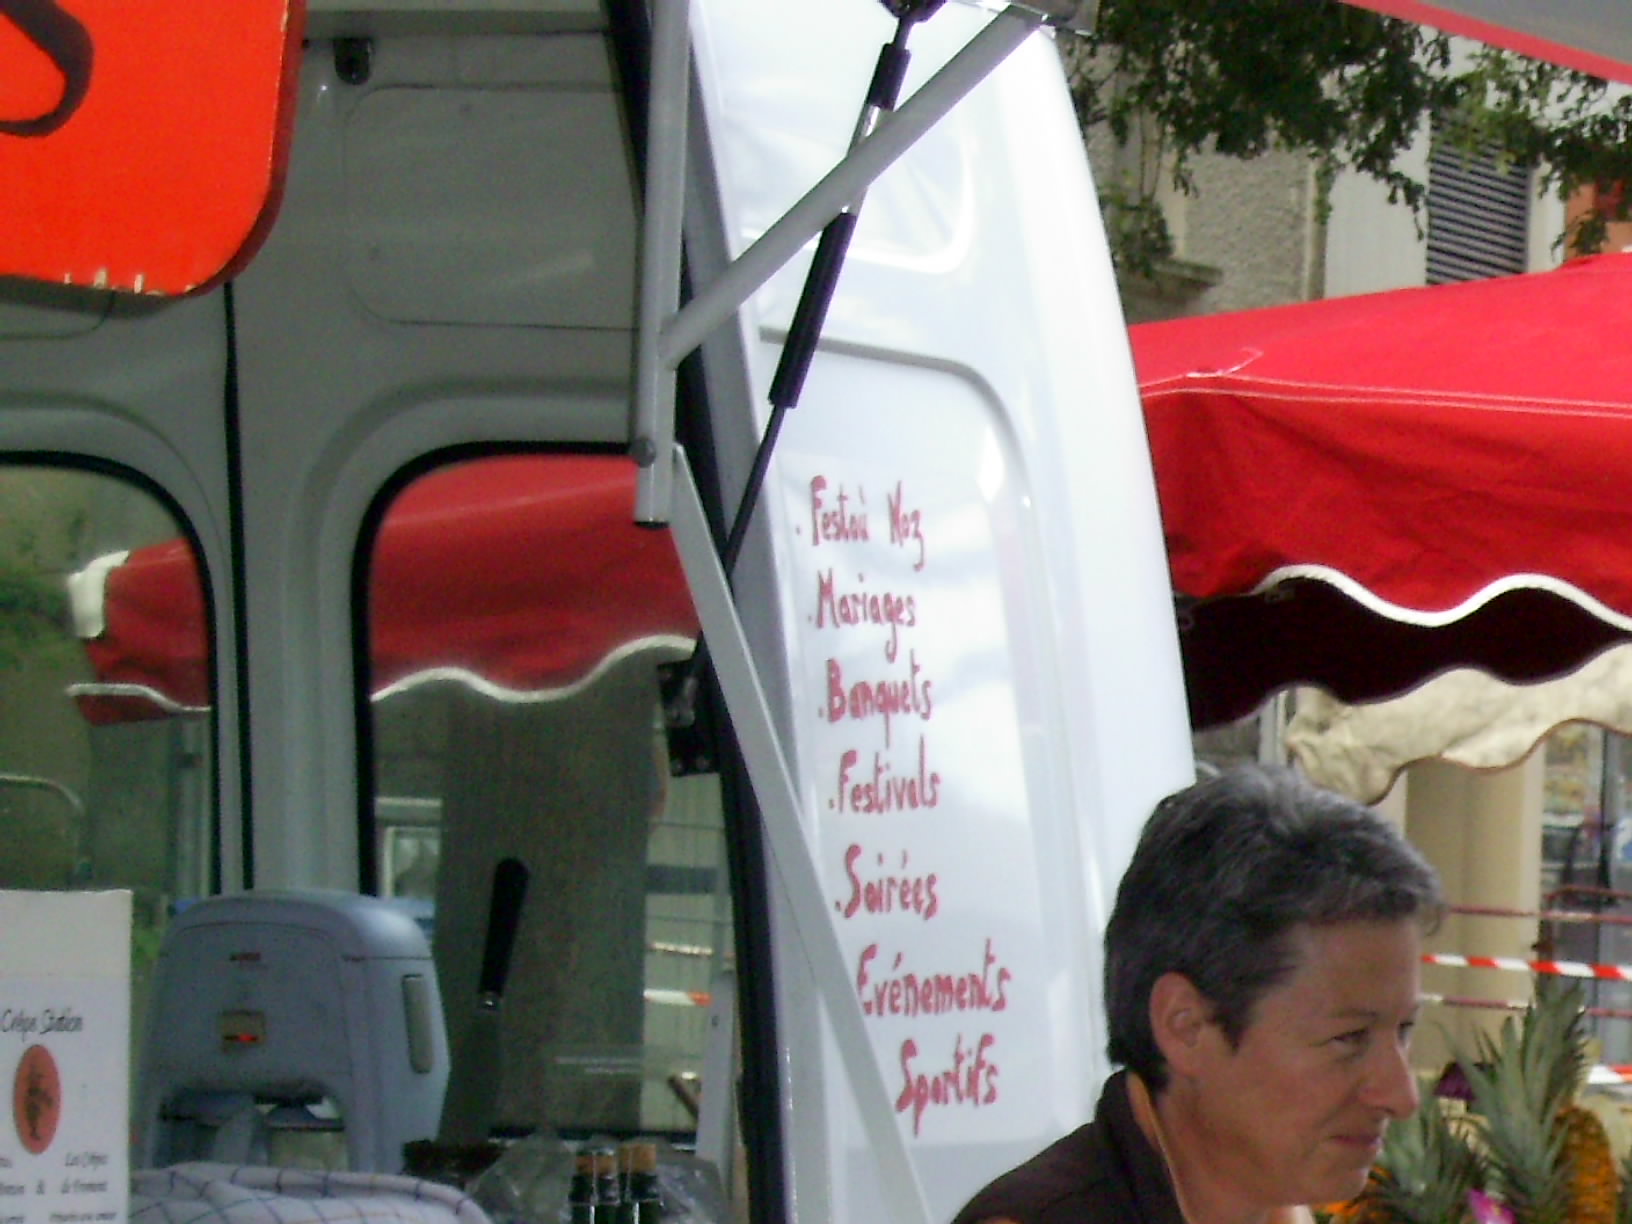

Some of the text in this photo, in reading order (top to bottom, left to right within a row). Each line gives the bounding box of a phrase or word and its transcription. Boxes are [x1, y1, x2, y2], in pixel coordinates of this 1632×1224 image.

[816, 567, 917, 664] Mariages
[826, 647, 932, 750] Banquets
[838, 733, 941, 814] Festivals
[842, 843, 938, 920] Soirées
[856, 937, 1012, 1017] Evénements
[895, 1032, 1000, 1139] Sportifs
